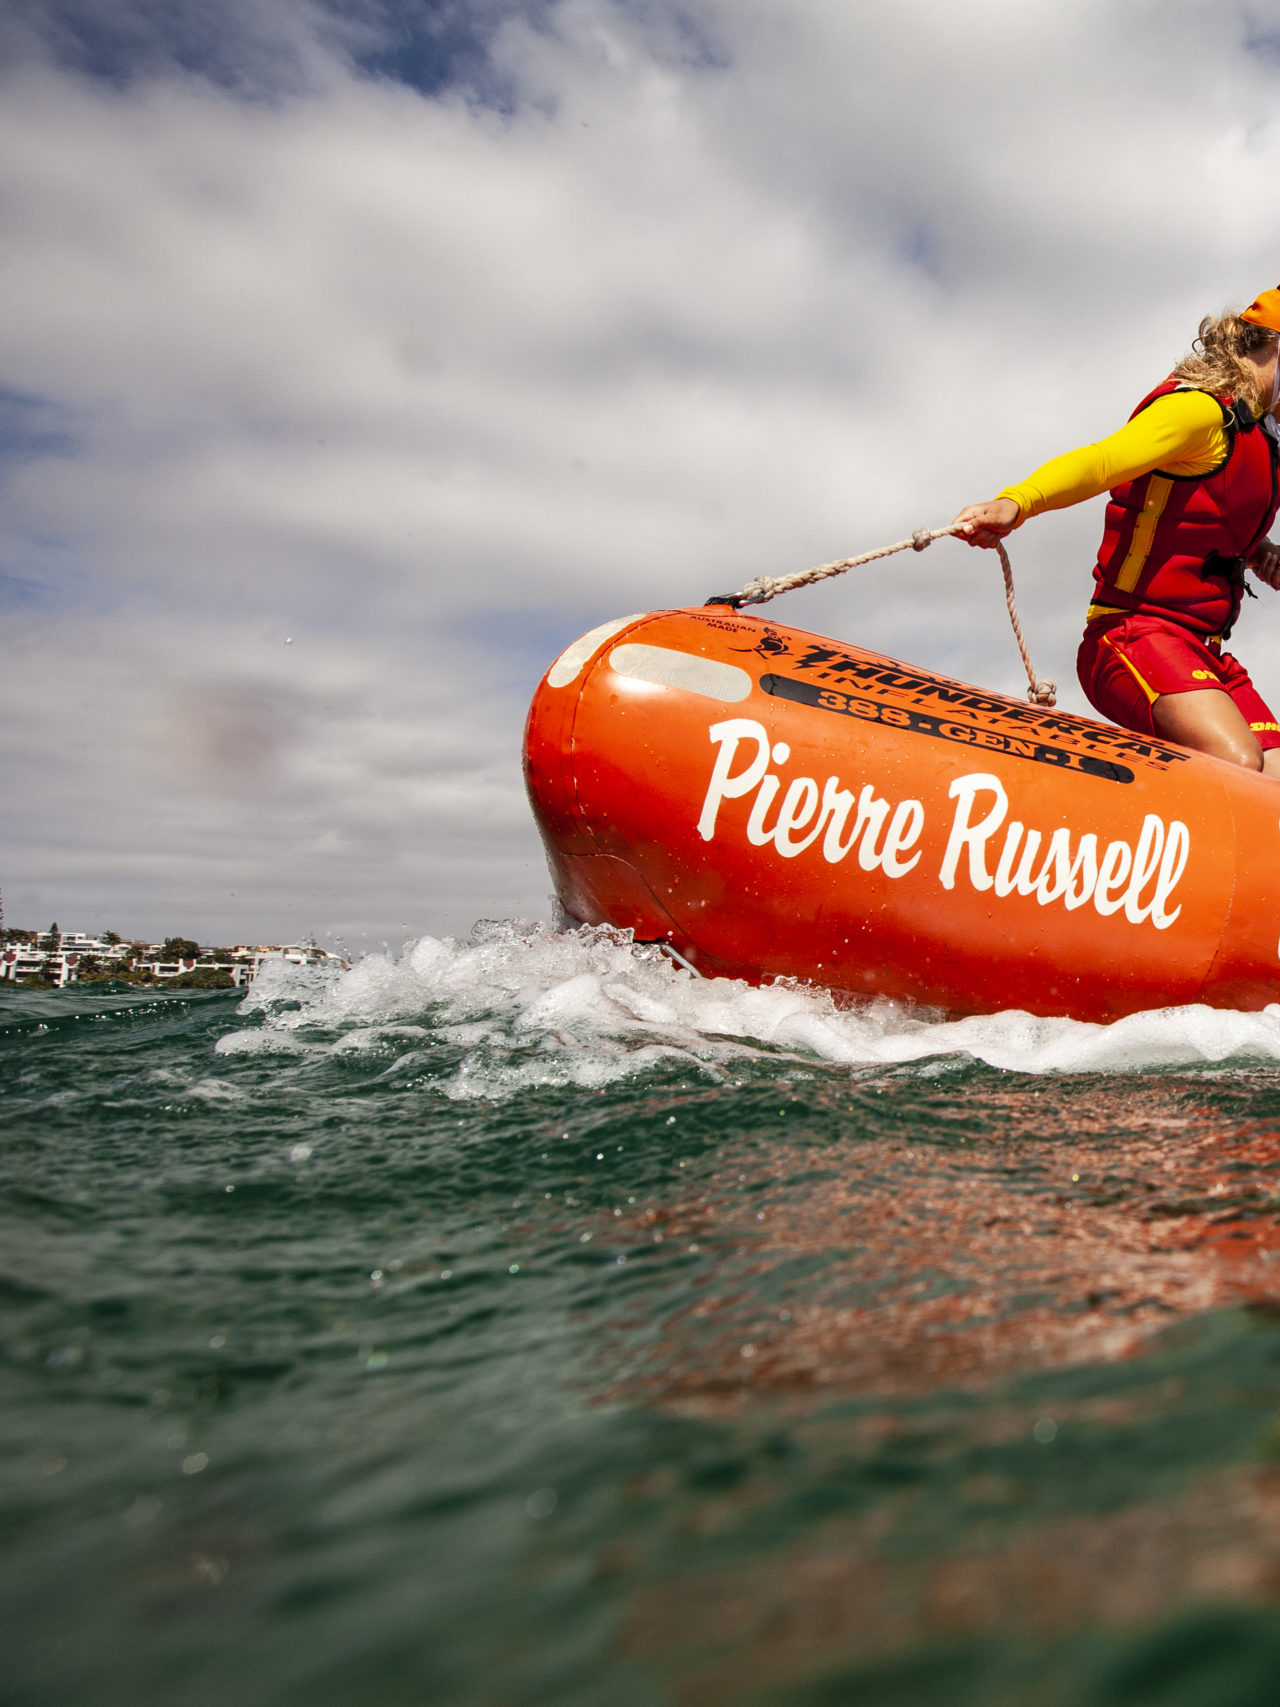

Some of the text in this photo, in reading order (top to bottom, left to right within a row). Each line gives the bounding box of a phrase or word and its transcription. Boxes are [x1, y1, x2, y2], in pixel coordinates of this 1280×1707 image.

[689, 615, 756, 633] AUSTRALIAN
[707, 622, 738, 633] MADE
[792, 645, 1192, 763] THUNDERCAT
[817, 672, 1170, 771] INFLATABLES
[697, 718, 1191, 930] Pierre Russell
